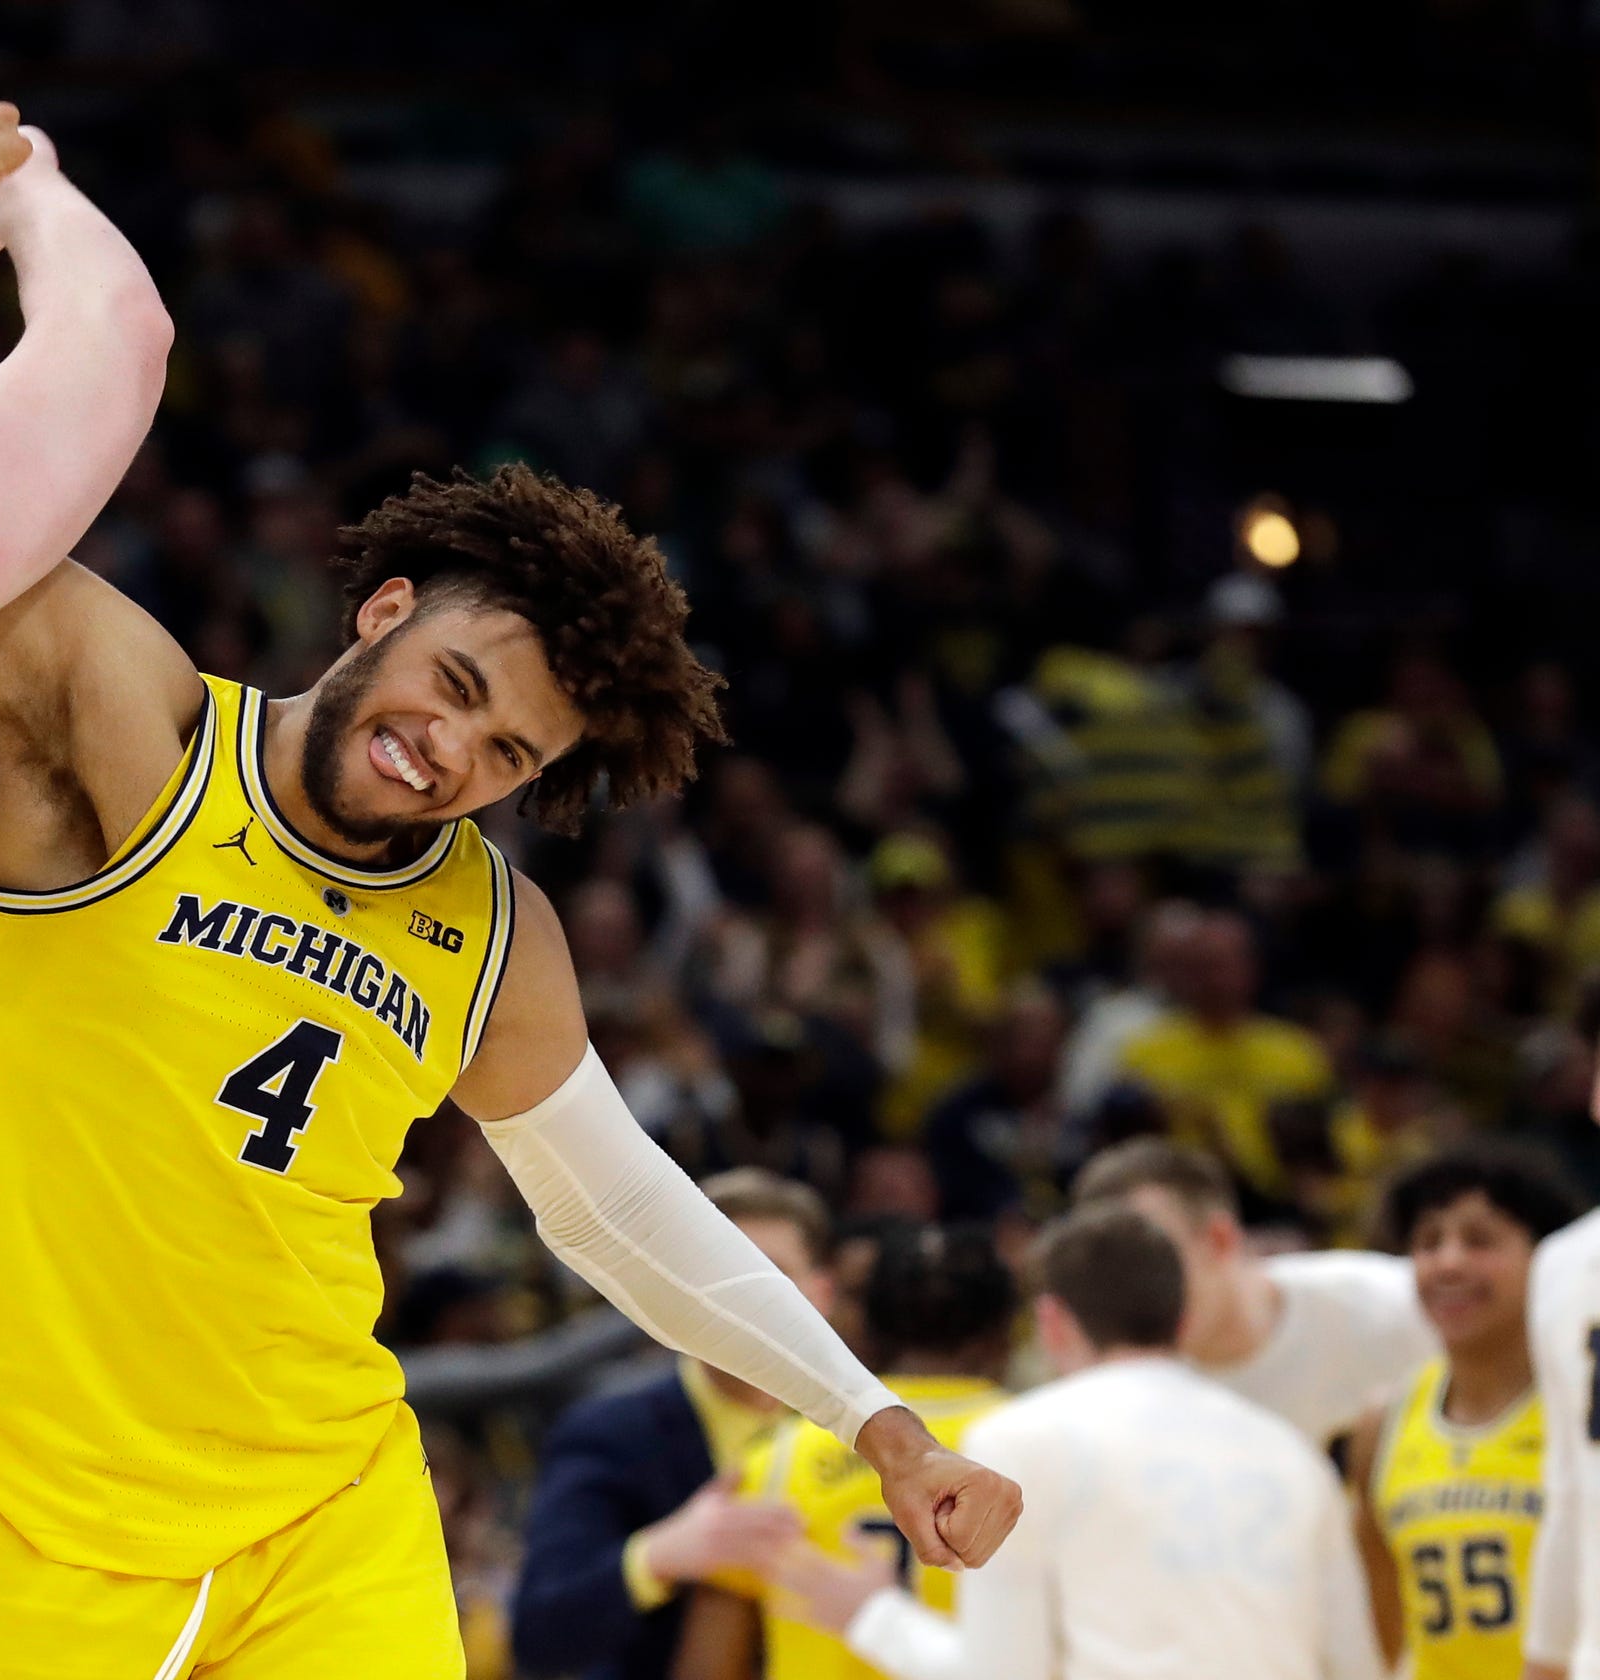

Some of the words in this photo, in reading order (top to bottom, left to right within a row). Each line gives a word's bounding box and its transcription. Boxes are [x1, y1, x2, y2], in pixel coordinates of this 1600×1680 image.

[155, 893, 431, 1062] MICHIGAN
[213, 1017, 345, 1175] 4
[1411, 1537, 1516, 1638] 55
